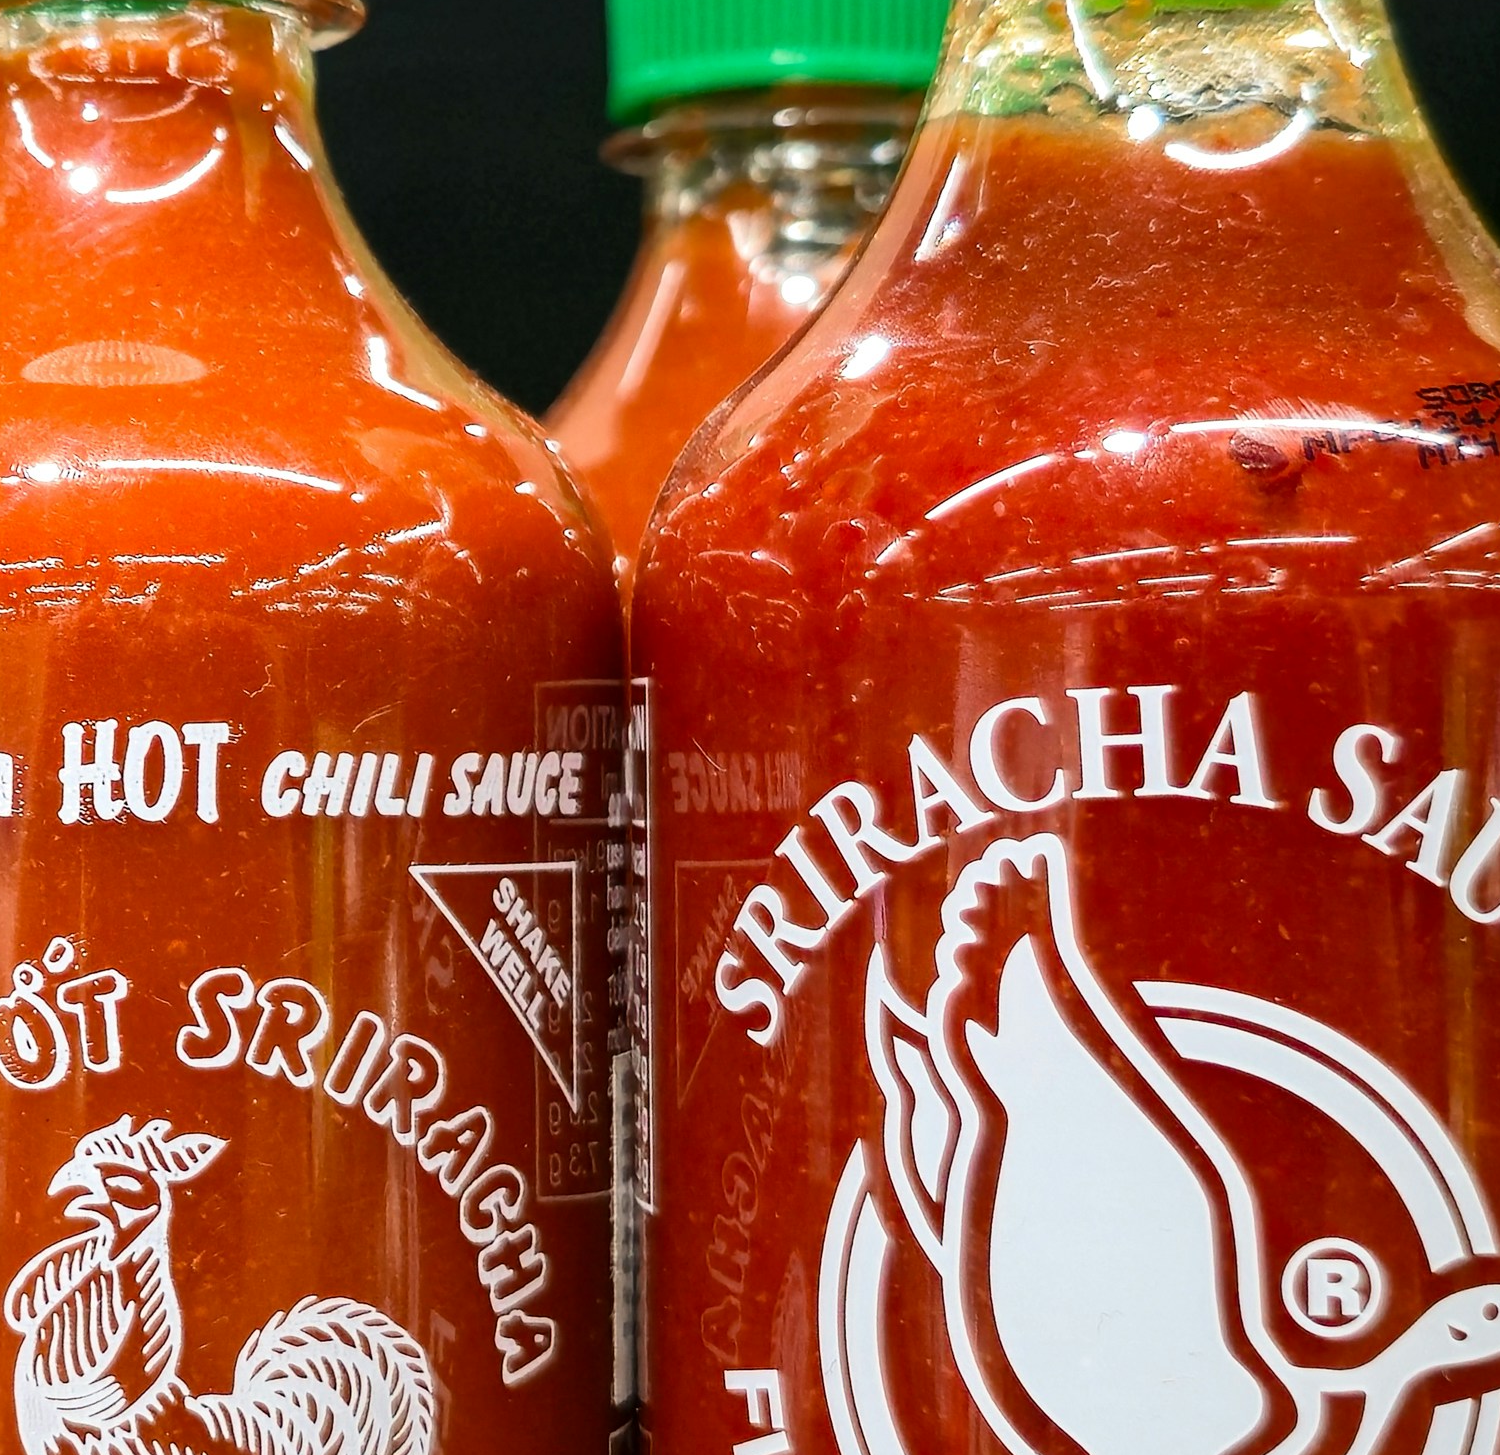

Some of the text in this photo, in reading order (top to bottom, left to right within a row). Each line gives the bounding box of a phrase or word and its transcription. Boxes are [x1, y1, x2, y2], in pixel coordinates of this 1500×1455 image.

[58, 719, 232, 825] HOT
[260, 750, 436, 818] CHILI
[441, 752, 583, 818] SAUCE
[714, 683, 1277, 1048] SRIRACHA
[478, 919, 547, 1032] WELL
[493, 876, 571, 1010] SHAKE
[176, 967, 558, 1386] SRIRACHA
